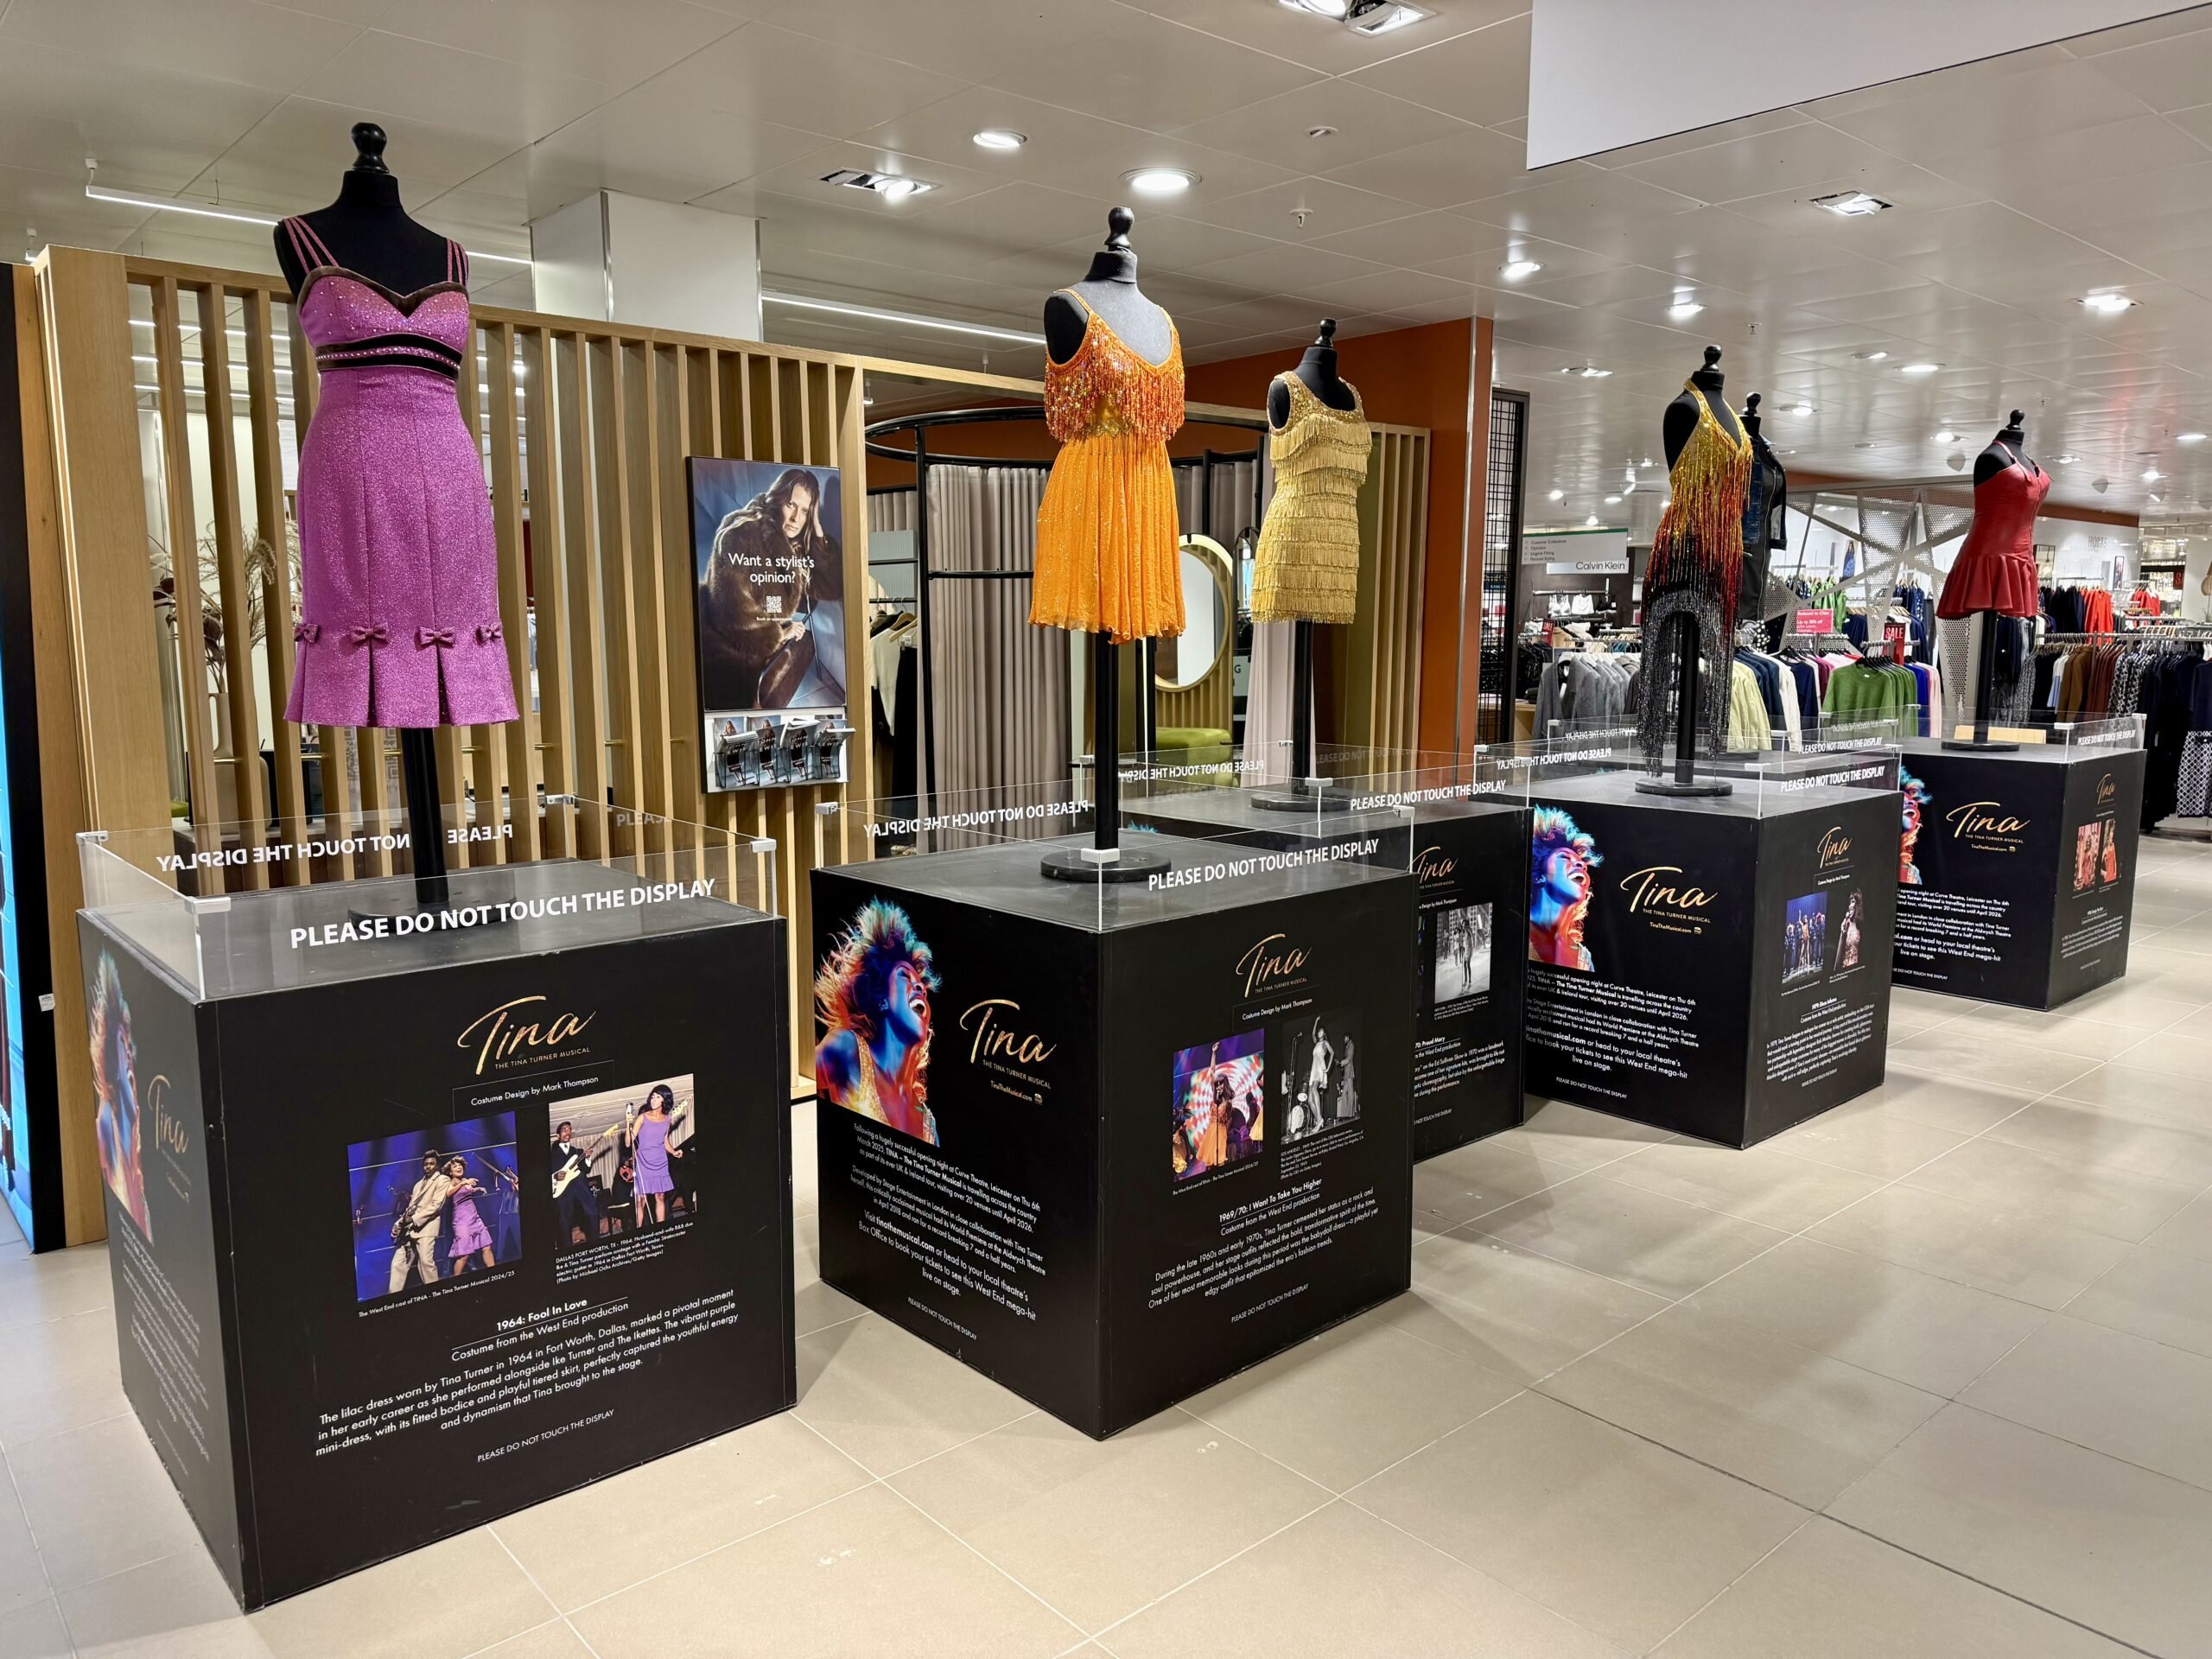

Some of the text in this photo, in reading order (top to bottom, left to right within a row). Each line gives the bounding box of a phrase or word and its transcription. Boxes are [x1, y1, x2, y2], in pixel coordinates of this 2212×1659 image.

[728, 553, 814, 570] Want a stylist's
[1576, 562, 1603, 570] Calvin
[750, 571, 795, 586] opinion?
[1885, 627, 1904, 639] SALE
[1818, 742, 1826, 752] DO
[1827, 741, 1837, 751] NOT
[1837, 741, 1853, 750] TOUCH
[1863, 737, 1883, 747] DISPLAY
[2078, 736, 2091, 745] PLEASE
[2105, 733, 2116, 741] TOUCH
[1351, 780, 1506, 810] PLEASE DO NOT TOUCH THE DISPLAY
[1781, 766, 1885, 793] PLEASE DO NOT TOUCH THE DISPLAY
[2096, 774, 2115, 804] Tina
[1946, 802, 2030, 838] Tina
[1817, 826, 1853, 868] Tina
[1148, 838, 1379, 892] PLEASE DO NOT TOUCH THE DISPLAY
[1620, 866, 1718, 912] Tina
[290, 879, 715, 948] PLEASE DO NOT TOUCH THE DISPLAY
[1971, 944, 1994, 952] theatre's
[1235, 933, 1312, 998] Tina
[457, 995, 596, 1075] Tina
[959, 999, 1056, 1064] Tina
[529, 1052, 556, 1062] TURNER
[559, 1047, 589, 1057] MUSICAL
[1572, 1054, 1582, 1064] live
[1593, 1061, 1611, 1071] stage.
[470, 1077, 598, 1105] Costume Design by Mark Thompson
[148, 1073, 190, 1154] Tina
[1219, 1205, 1248, 1222] 1969/70:
[1252, 1198, 1268, 1209] Want
[1277, 1190, 1290, 1199] Take
[1303, 1179, 1321, 1190] Higher
[864, 1210, 875, 1222] Visit
[876, 1216, 934, 1253] tinathemusical.com
[944, 1249, 959, 1265] head
[960, 1259, 966, 1268] to
[968, 1265, 982, 1277] your
[983, 1268, 999, 1287] local
[1001, 1279, 1028, 1301] theatre's
[496, 1300, 587, 1331] 1964: Fool In Love
[451, 1303, 627, 1361] Costume from the West End production
[319, 1413, 338, 1424] The
[340, 1406, 363, 1418] lilac
[365, 1396, 393, 1410] dress
[396, 1388, 422, 1400] worn
[424, 1382, 437, 1392] by
[440, 1376, 461, 1386] Tina
[463, 1365, 493, 1379] Turner
[496, 1361, 504, 1370] in
[508, 1351, 532, 1365] 1964
[546, 1342, 563, 1354] Fort
[565, 1332, 595, 1347] Worth,
[598, 1324, 627, 1338] Dallas,
[630, 1309, 662, 1327] marked
[672, 1298, 699, 1317] pivotal
[702, 1289, 733, 1305] moment
